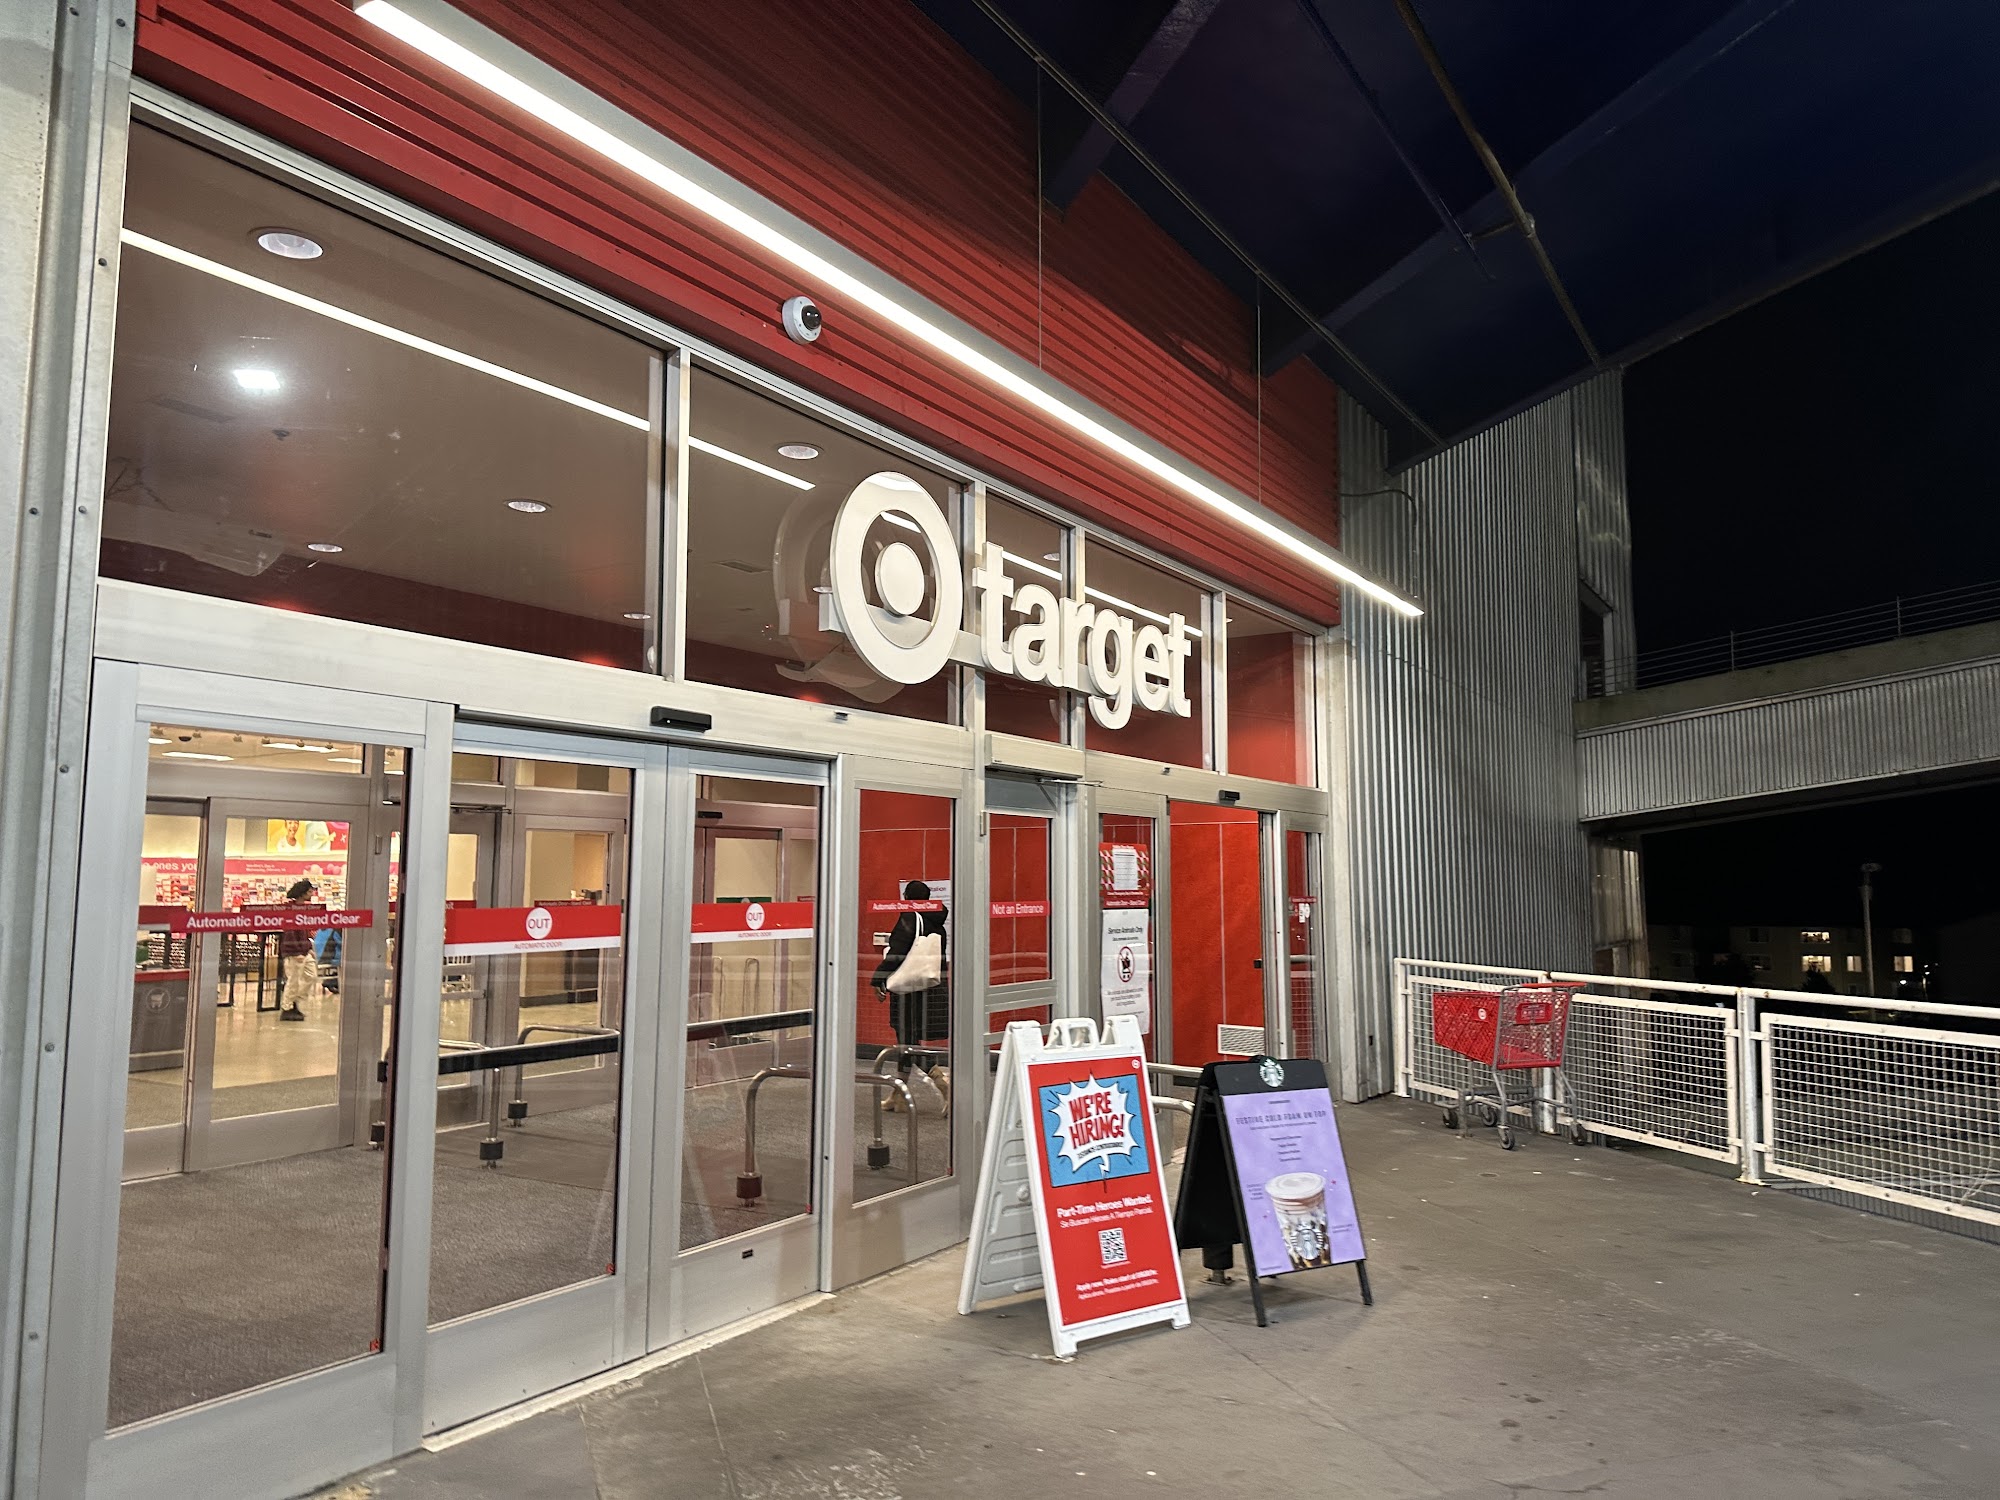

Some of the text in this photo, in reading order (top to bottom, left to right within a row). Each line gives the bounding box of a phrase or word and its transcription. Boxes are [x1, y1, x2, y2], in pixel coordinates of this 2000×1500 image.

[972, 541, 1192, 730] target
[872, 902, 897, 911] Automatic
[897, 902, 909, 910] Door
[912, 902, 926, 910] Stand
[926, 901, 938, 910] Clear
[992, 903, 1044, 915] Not an Entrance
[186, 914, 251, 928] Automatic
[254, 913, 284, 927] Door
[295, 913, 328, 926] Stand
[330, 912, 360, 925] Clear
[747, 911, 763, 922] OUT
[527, 917, 551, 930] OUT
[514, 941, 563, 950] AUTOMATIC DOOR
[1068, 1091, 1113, 1123] WE'RE
[1265, 1114, 1282, 1123] COLD
[1068, 1113, 1125, 1150] HIRING!
[1056, 1204, 1096, 1218] Part-Time
[1095, 1201, 1123, 1212] Heroes
